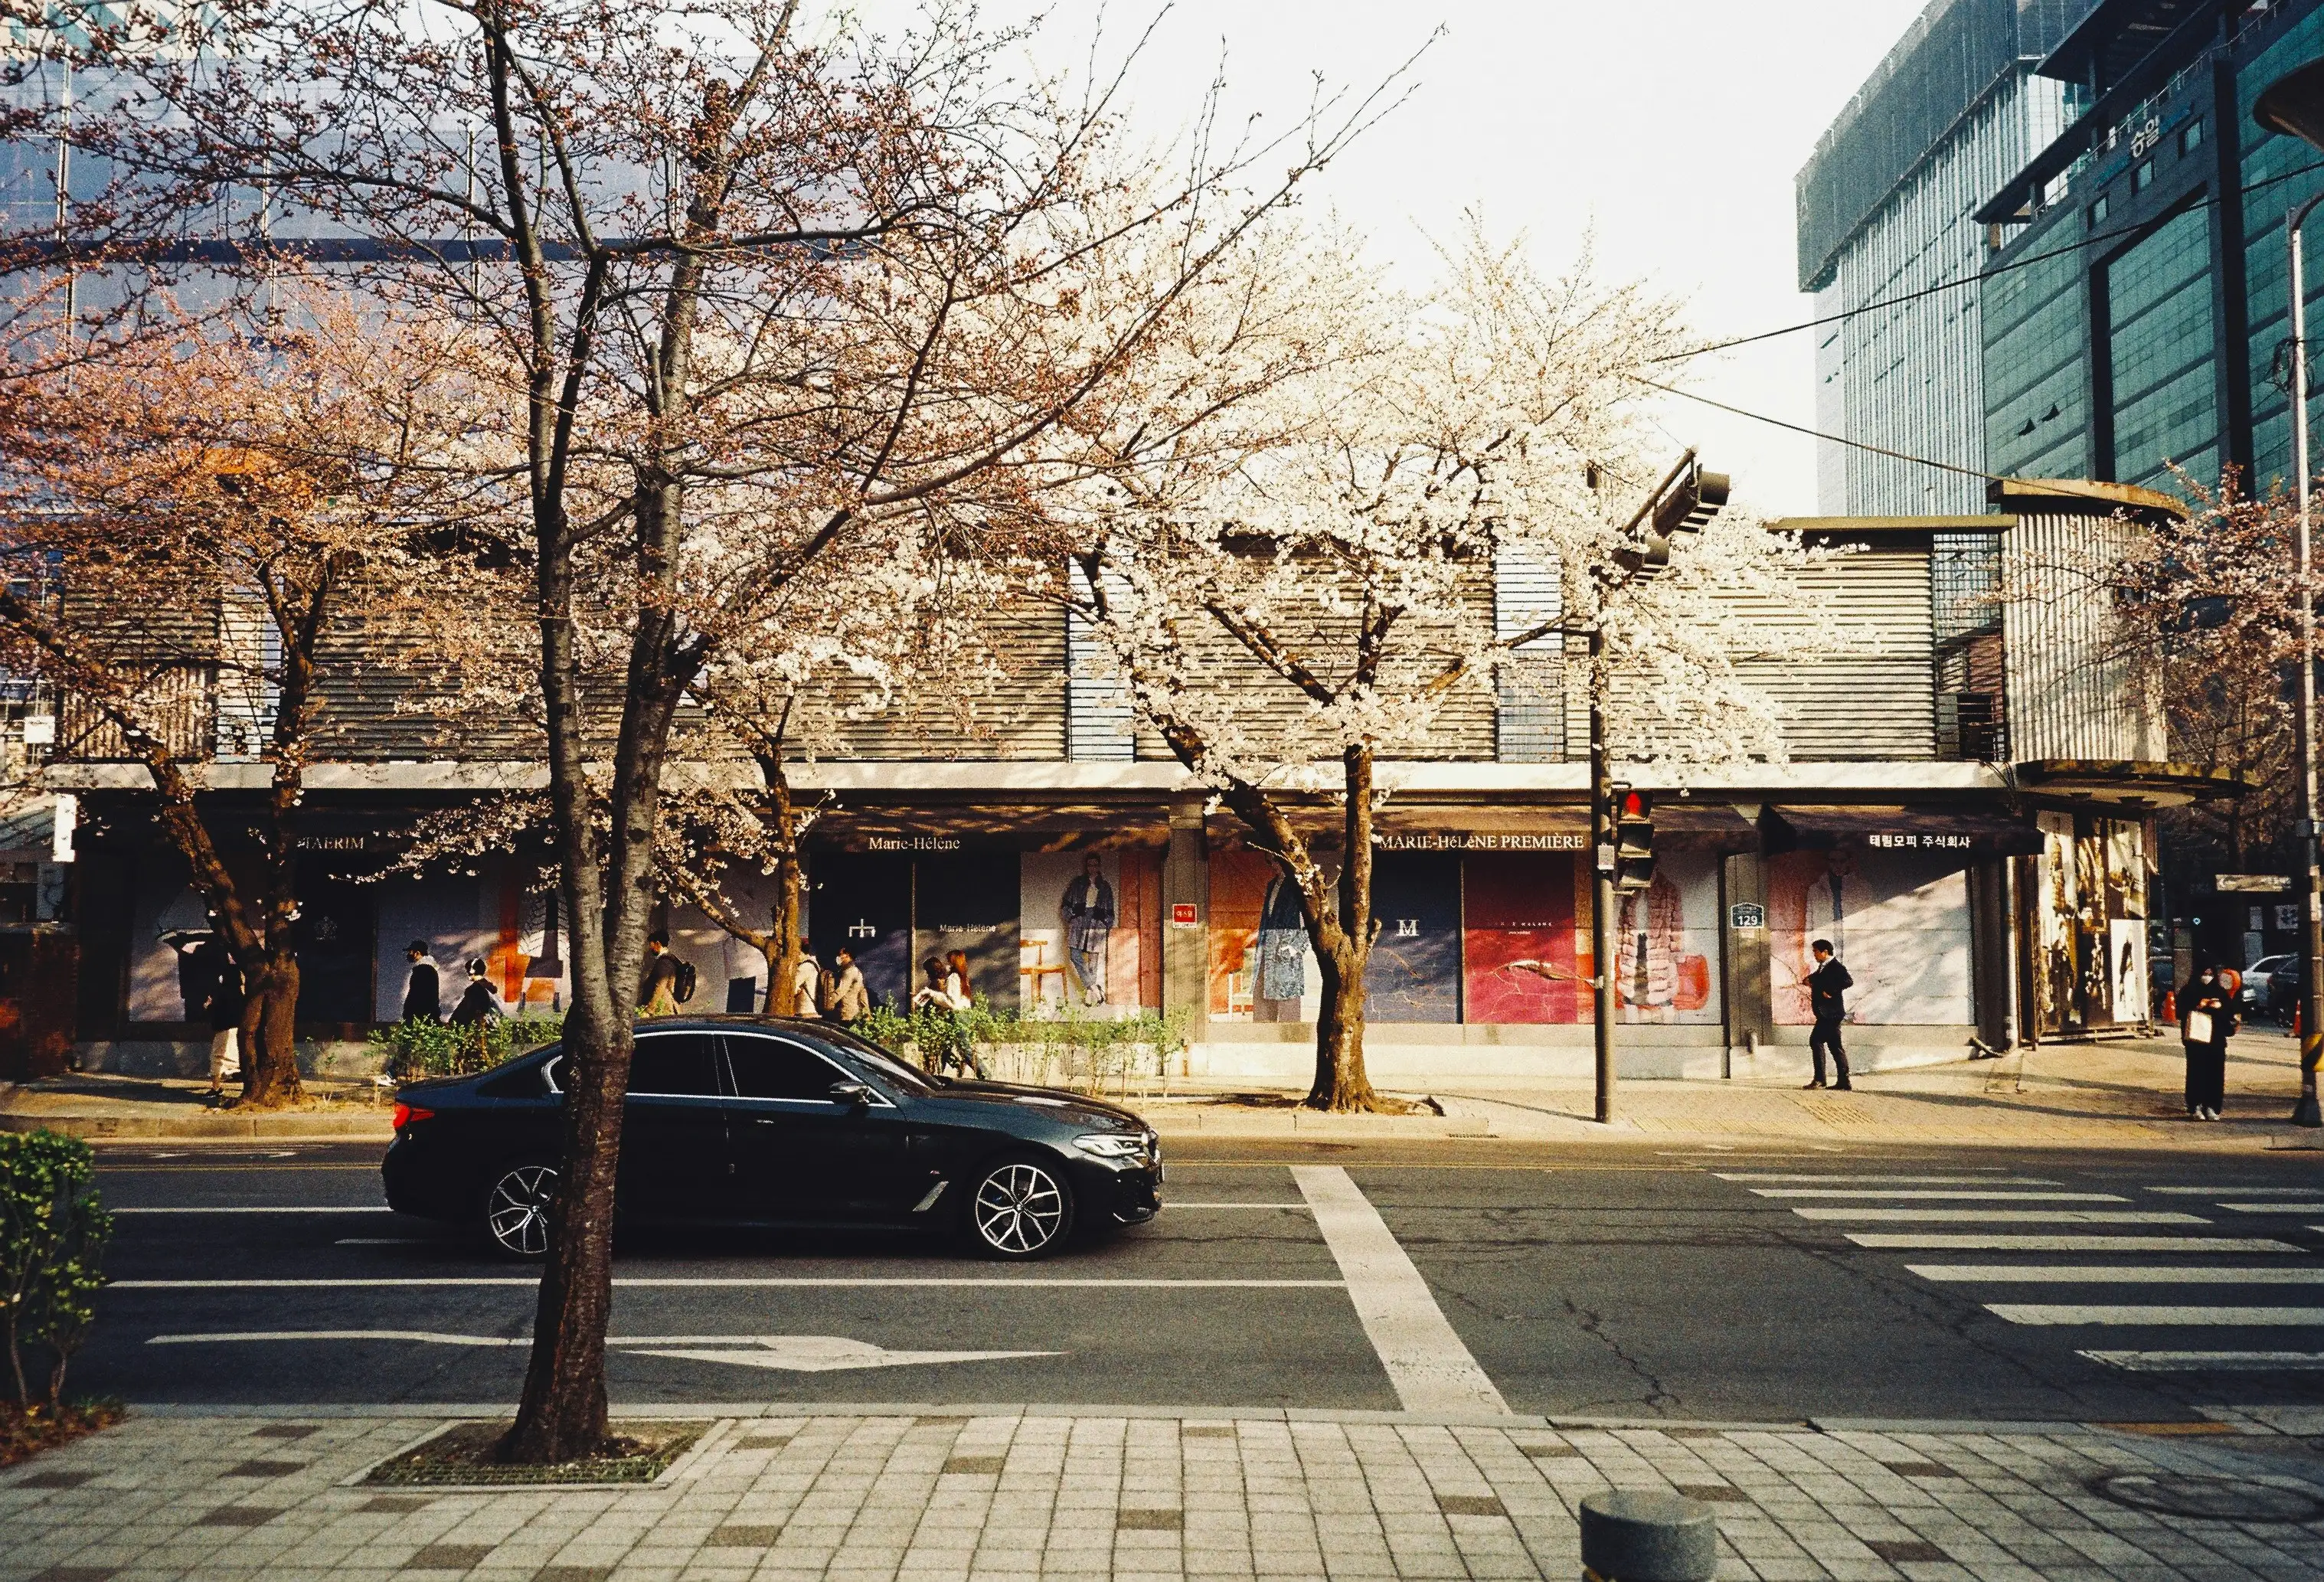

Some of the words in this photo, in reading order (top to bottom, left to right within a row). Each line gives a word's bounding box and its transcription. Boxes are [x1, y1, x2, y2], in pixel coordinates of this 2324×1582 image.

[868, 837, 960, 849] Marie-Hélène
[1501, 832, 1584, 849] PREMIÈRE
[1869, 835, 1917, 848] 태림모피
[1922, 835, 1970, 848] 주식회사
[1738, 915, 1758, 926] 129
[1396, 919, 1420, 936] M
